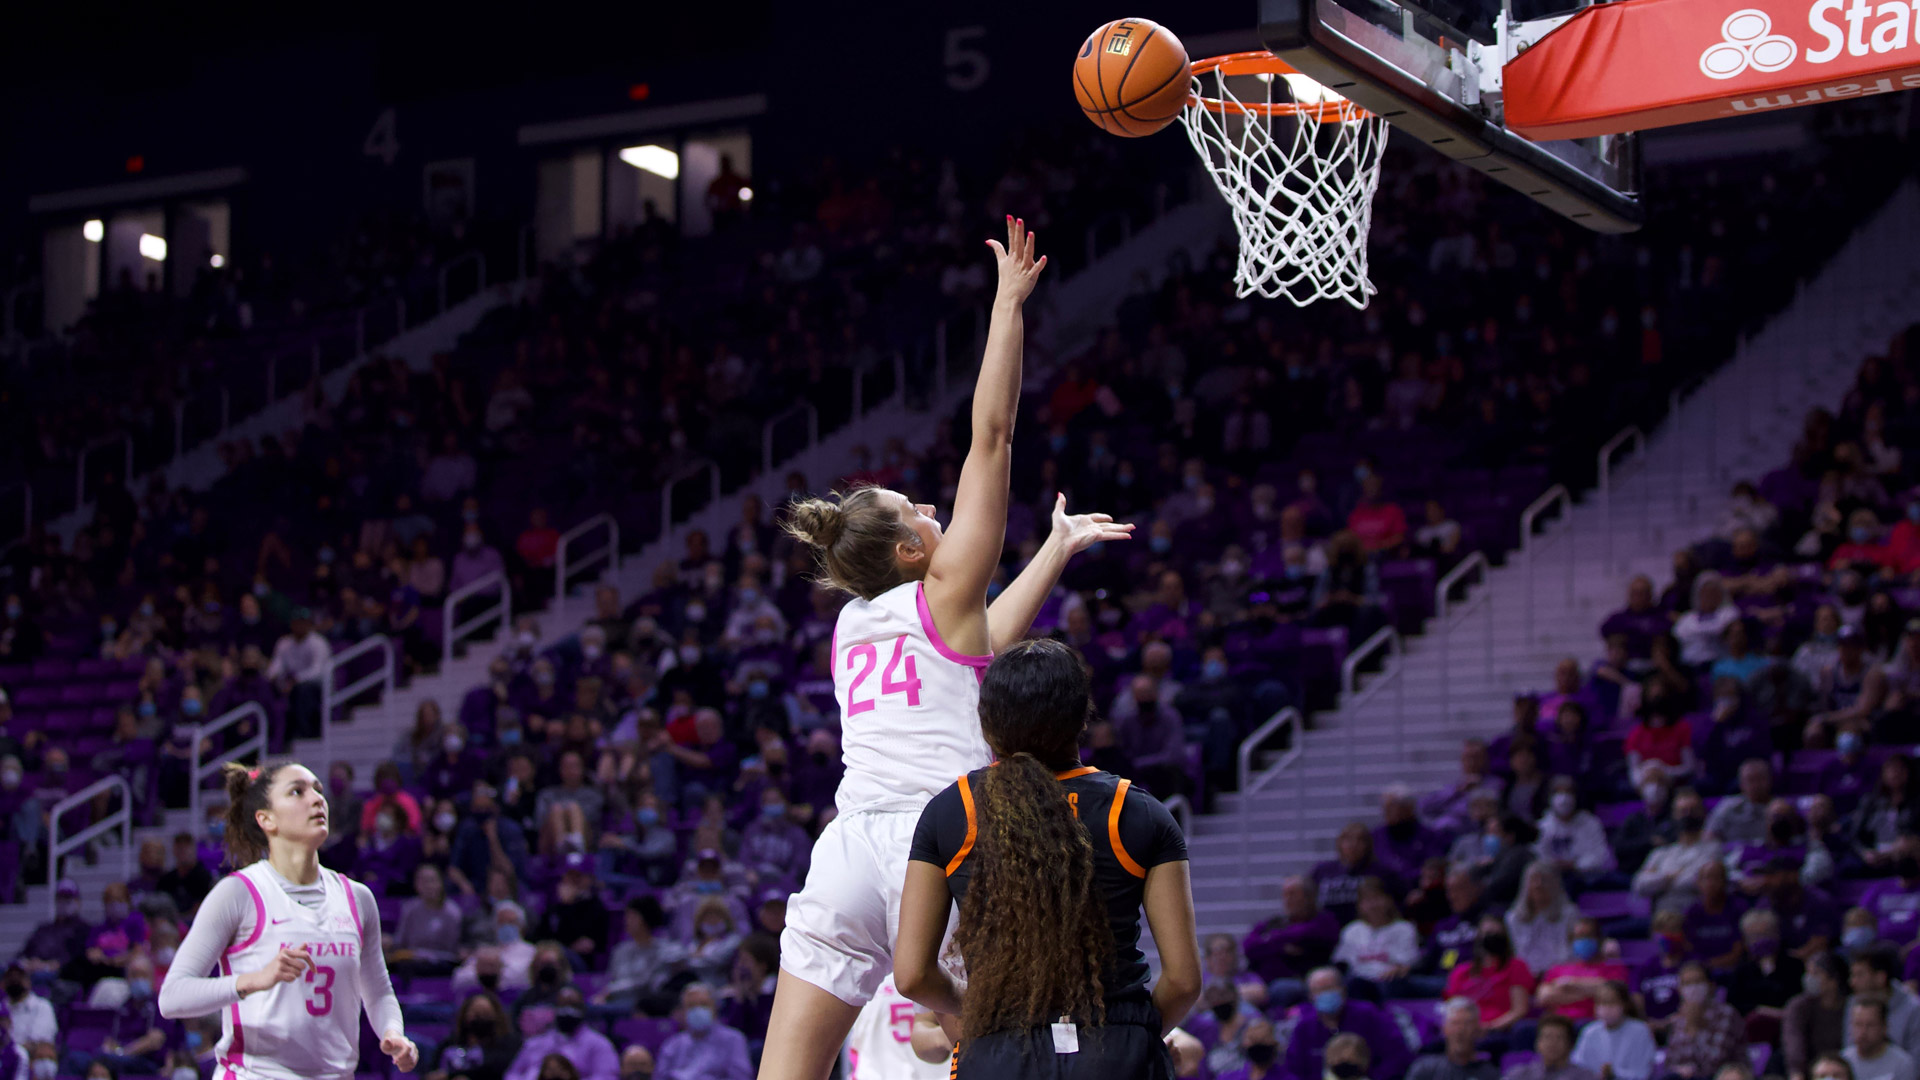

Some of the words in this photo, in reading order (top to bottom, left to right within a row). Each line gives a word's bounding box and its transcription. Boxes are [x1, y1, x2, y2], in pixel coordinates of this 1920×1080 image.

[944, 26, 990, 92] 5
[1105, 20, 1139, 55] ELIT
[1805, 0, 1920, 64] Sta
[1730, 78, 1895, 111] Farm
[362, 107, 401, 166] 4
[847, 633, 922, 718] 24
[305, 965, 336, 1017] 3
